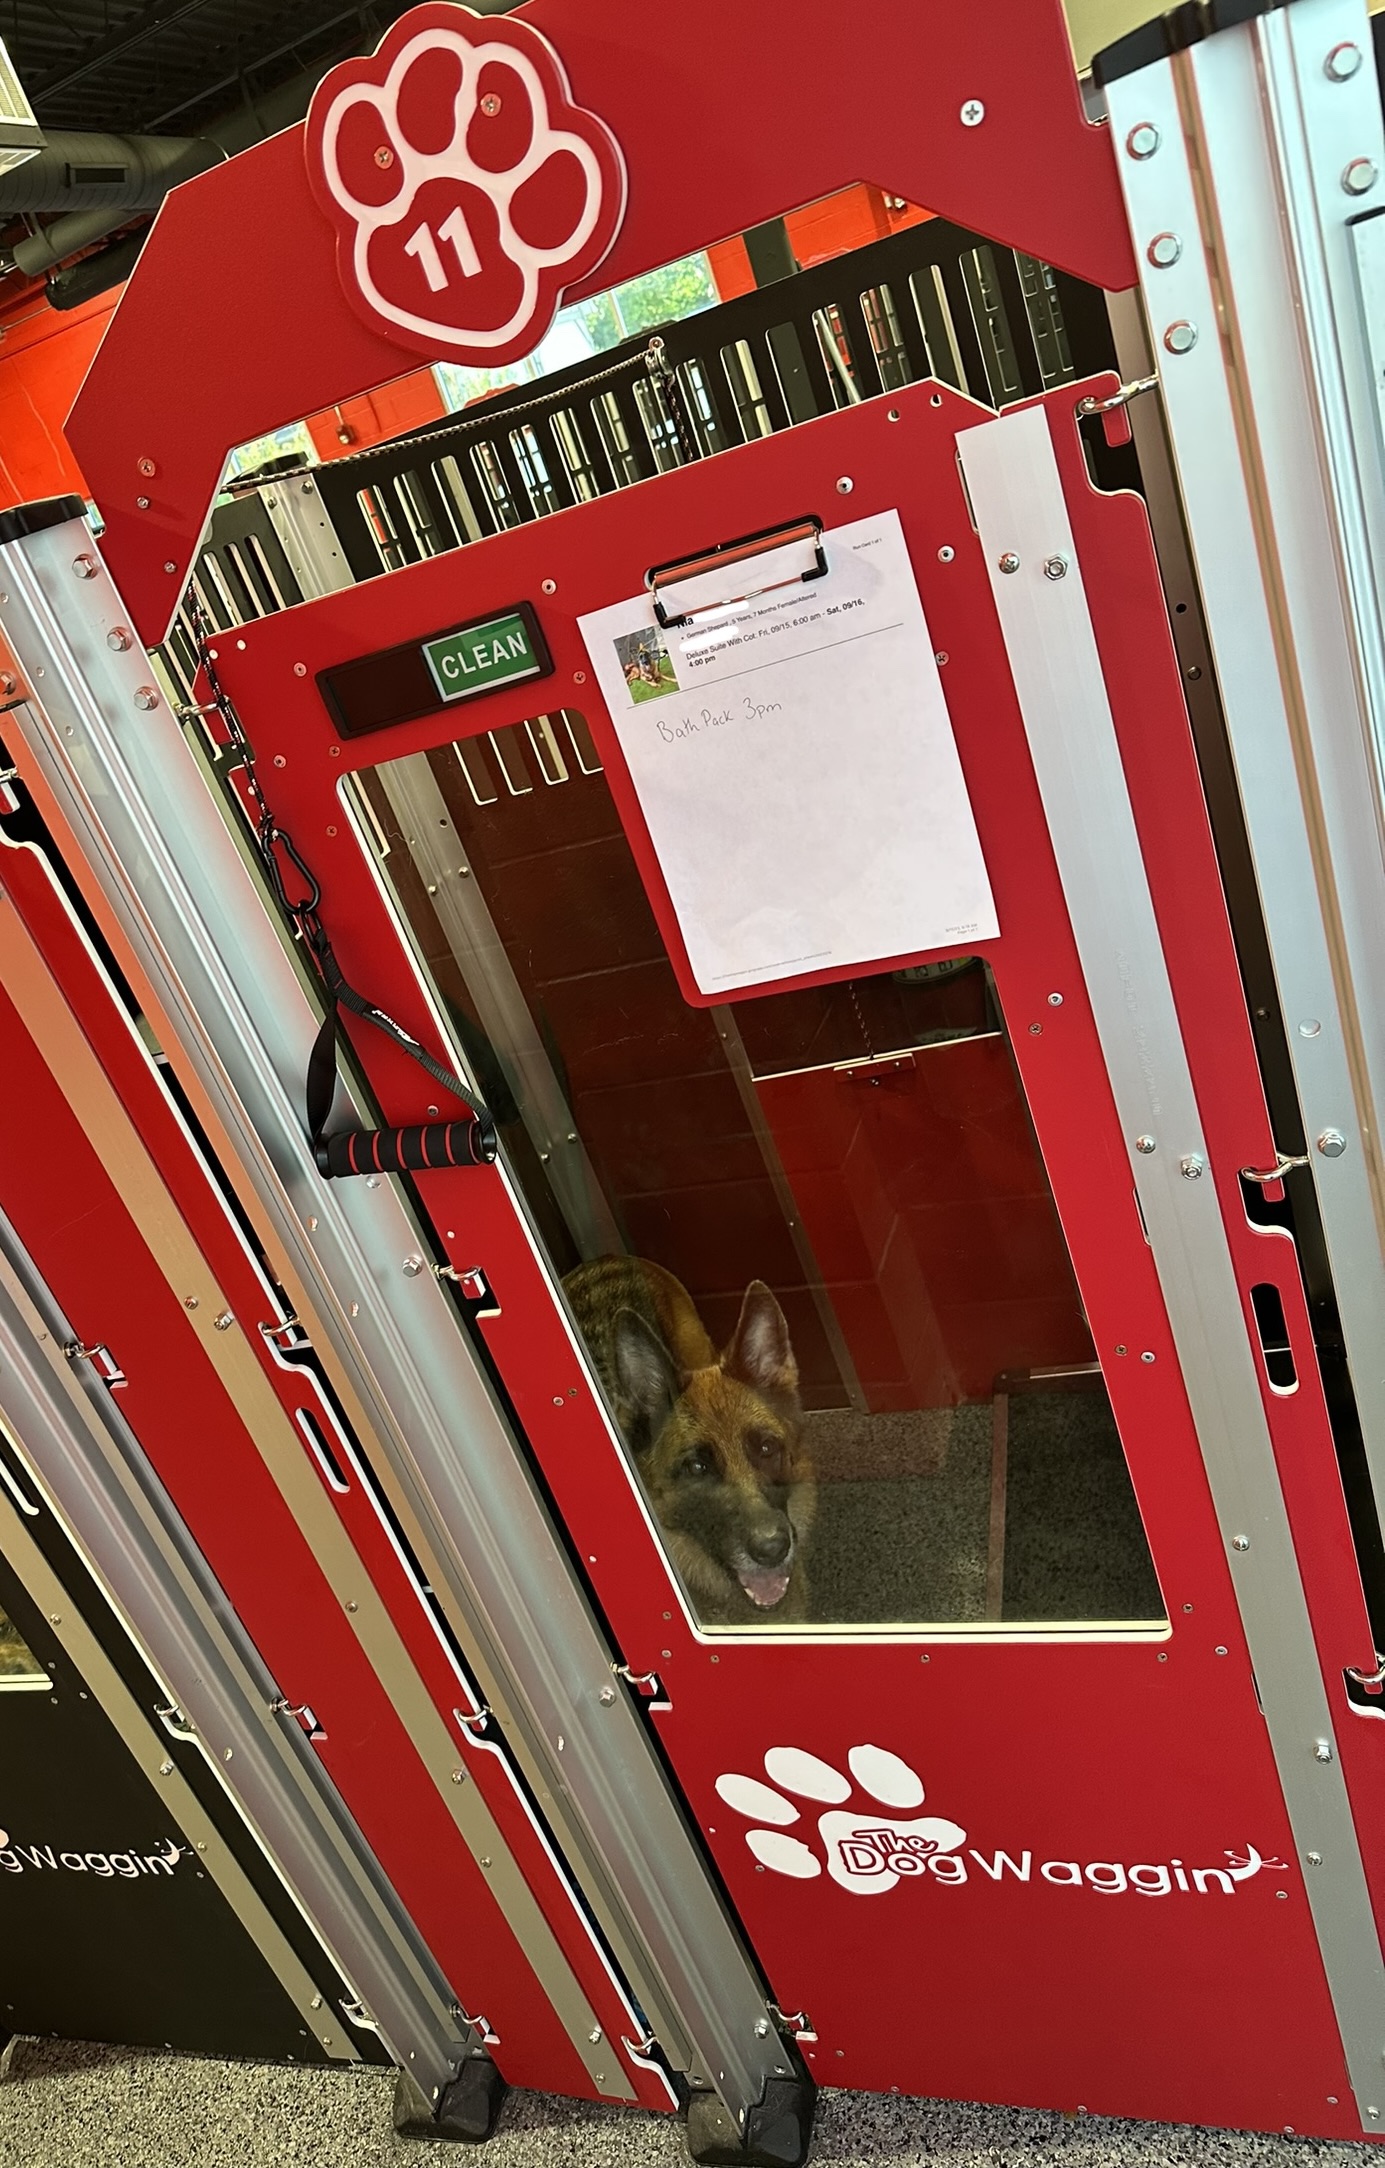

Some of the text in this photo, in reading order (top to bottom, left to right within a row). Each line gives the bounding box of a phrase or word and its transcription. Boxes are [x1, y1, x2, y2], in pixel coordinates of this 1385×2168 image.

[404, 206, 482, 293] 11
[686, 628, 707, 639] German
[707, 621, 729, 632] Shepard
[736, 614, 753, 622] Years,
[757, 606, 777, 616] Months
[777, 592, 817, 609] Female/Altered
[686, 648, 709, 660] Deluxe
[709, 642, 726, 653] Suite
[727, 637, 743, 647] With
[758, 629, 771, 638] Fri,
[770, 622, 792, 634] 09/15,
[793, 616, 809, 627] 6:00
[809, 612, 821, 622] am
[826, 606, 842, 616] Sat,
[842, 598, 865, 611] 09/16,
[440, 631, 528, 679] CLEAN
[689, 655, 716, 668] 4:00 pm
[656, 697, 782, 743] Bath Pack 3pm
[838, 1840, 968, 1886] Dog
[851, 1827, 939, 1853] The
